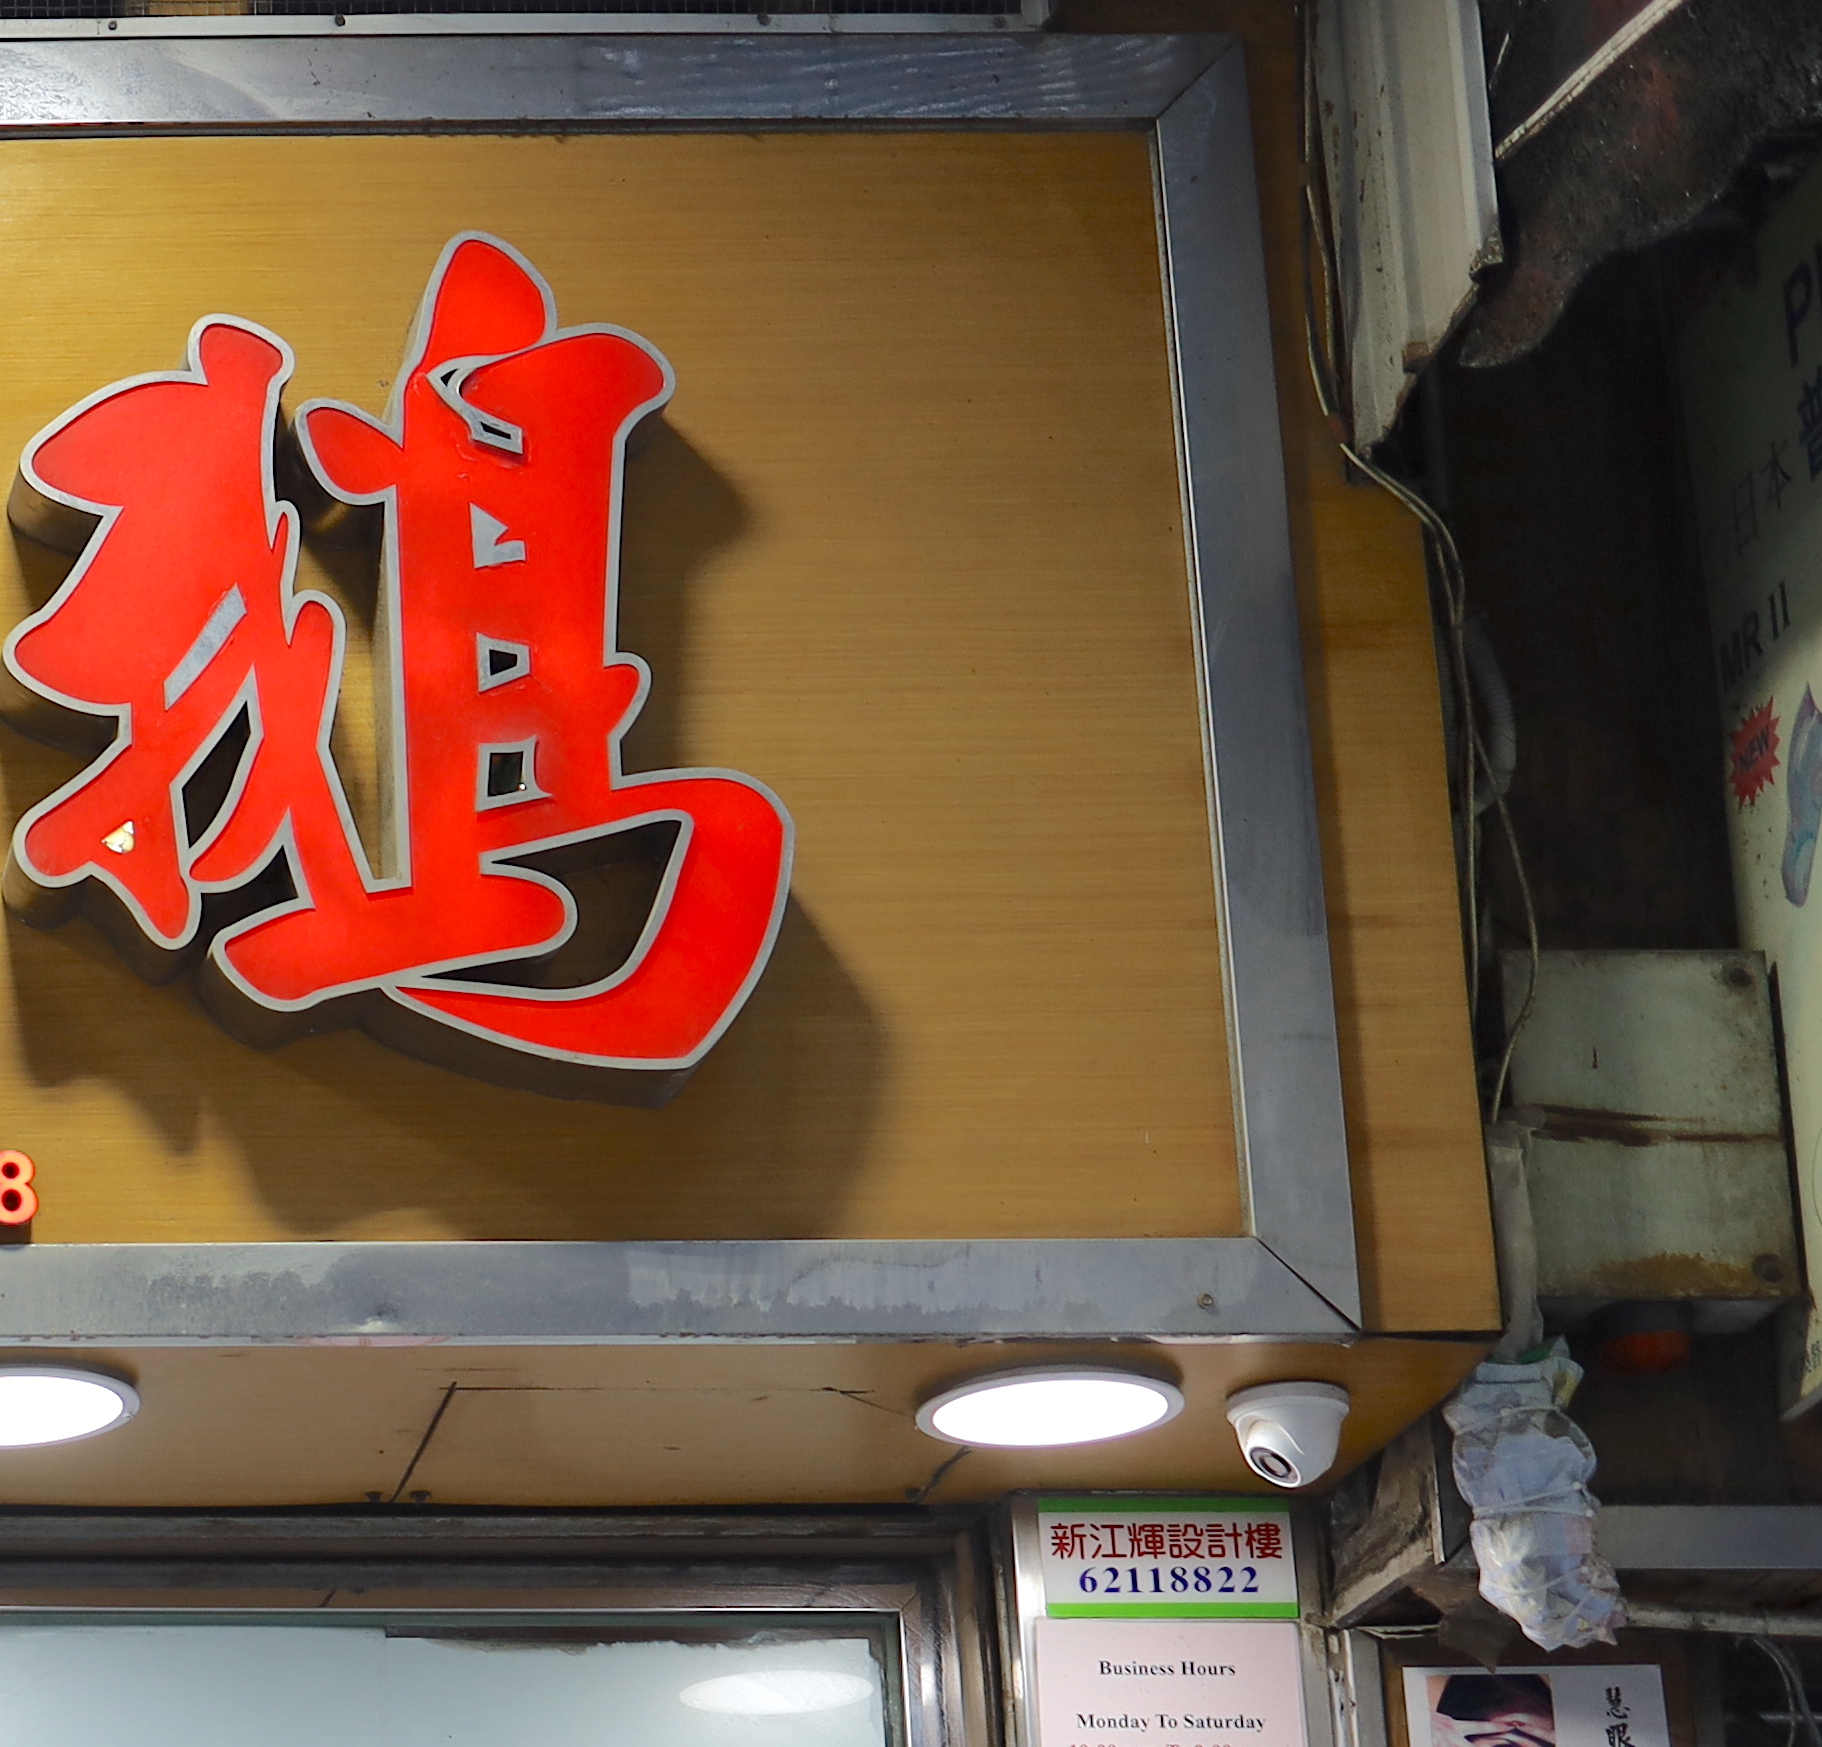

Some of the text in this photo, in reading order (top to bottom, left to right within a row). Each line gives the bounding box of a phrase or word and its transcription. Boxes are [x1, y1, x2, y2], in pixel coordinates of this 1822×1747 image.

[1050, 1523, 1282, 1560] 新江輝設計樓
[1079, 1566, 1260, 1594] 62118822
[1099, 1660, 1236, 1676] Business Hours
[1077, 1714, 1266, 1732] Monday Saturday
